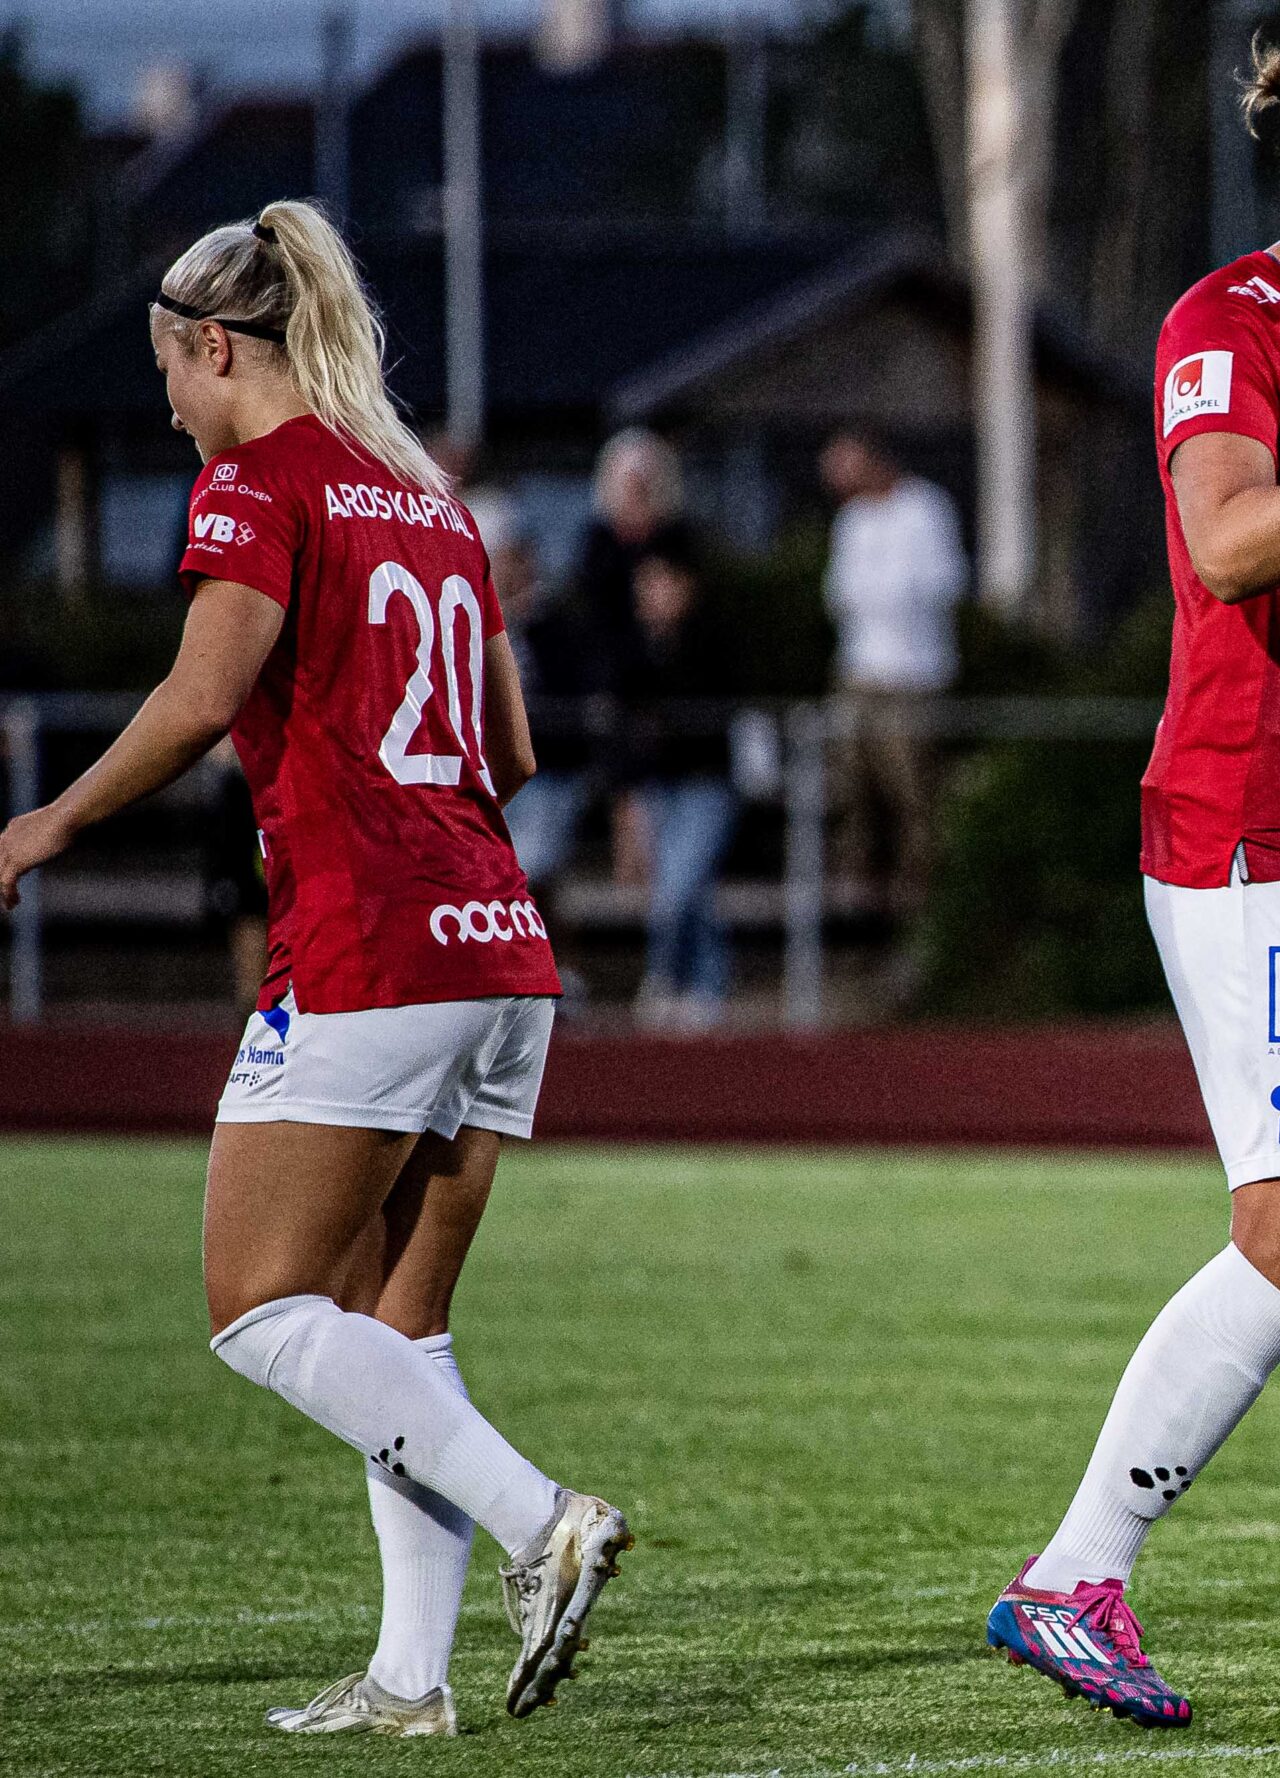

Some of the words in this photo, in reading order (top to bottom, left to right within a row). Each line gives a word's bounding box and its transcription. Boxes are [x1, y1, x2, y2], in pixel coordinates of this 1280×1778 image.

[1194, 399, 1220, 409] SPEL
[367, 560, 498, 797] 20
[247, 1046, 285, 1066] Hamn
